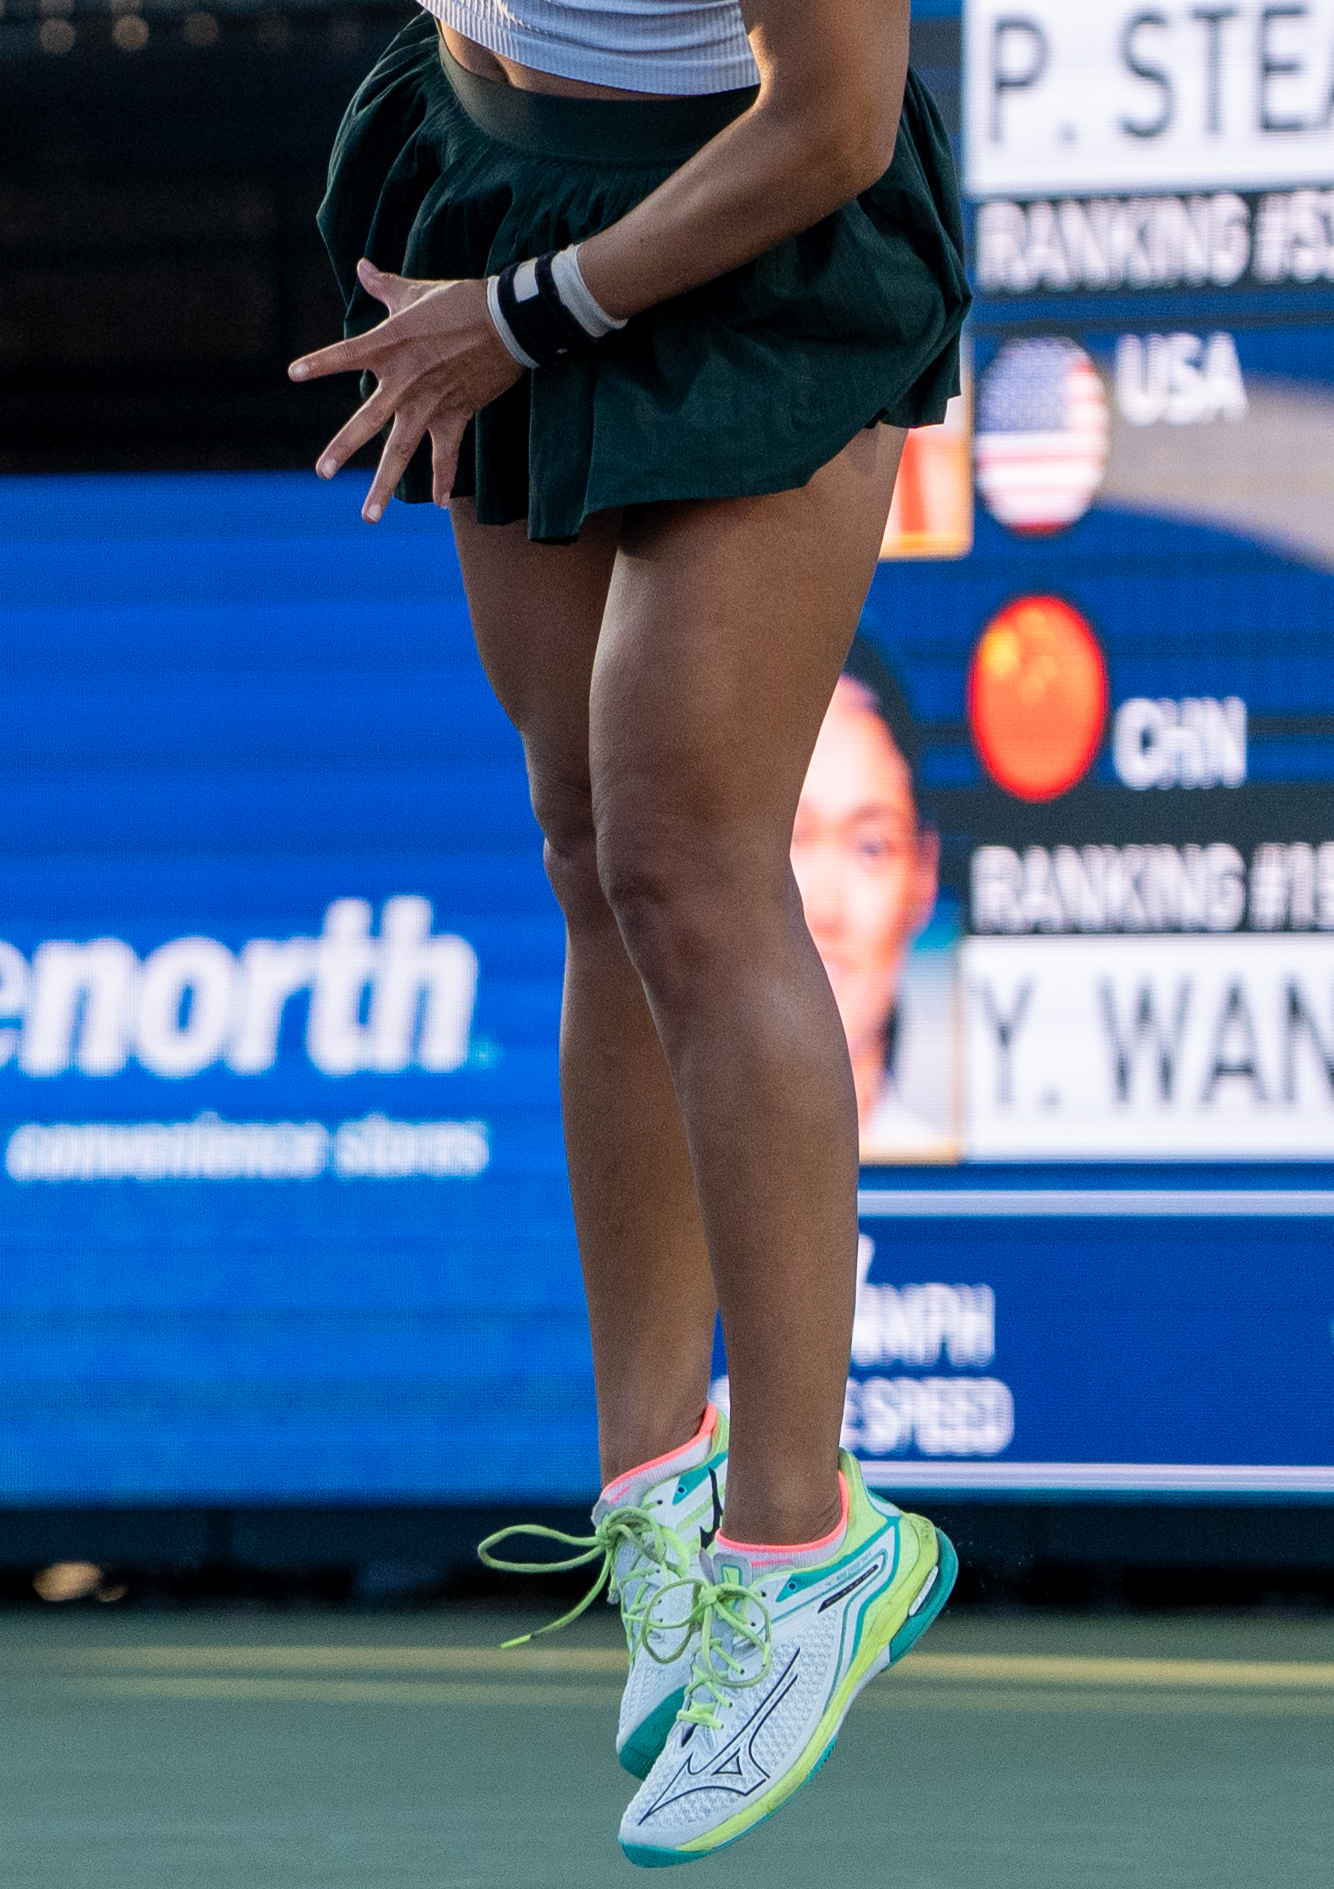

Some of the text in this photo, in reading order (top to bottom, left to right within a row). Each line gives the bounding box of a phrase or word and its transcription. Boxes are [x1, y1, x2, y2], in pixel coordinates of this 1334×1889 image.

[985, 10, 1075, 146] P.
[975, 197, 1252, 292] RANKING
[1115, 331, 1248, 426] USA
[1114, 695, 1247, 790] CHN
[971, 843, 1246, 933] RANKING
[973, 972, 1061, 1108] Y.
